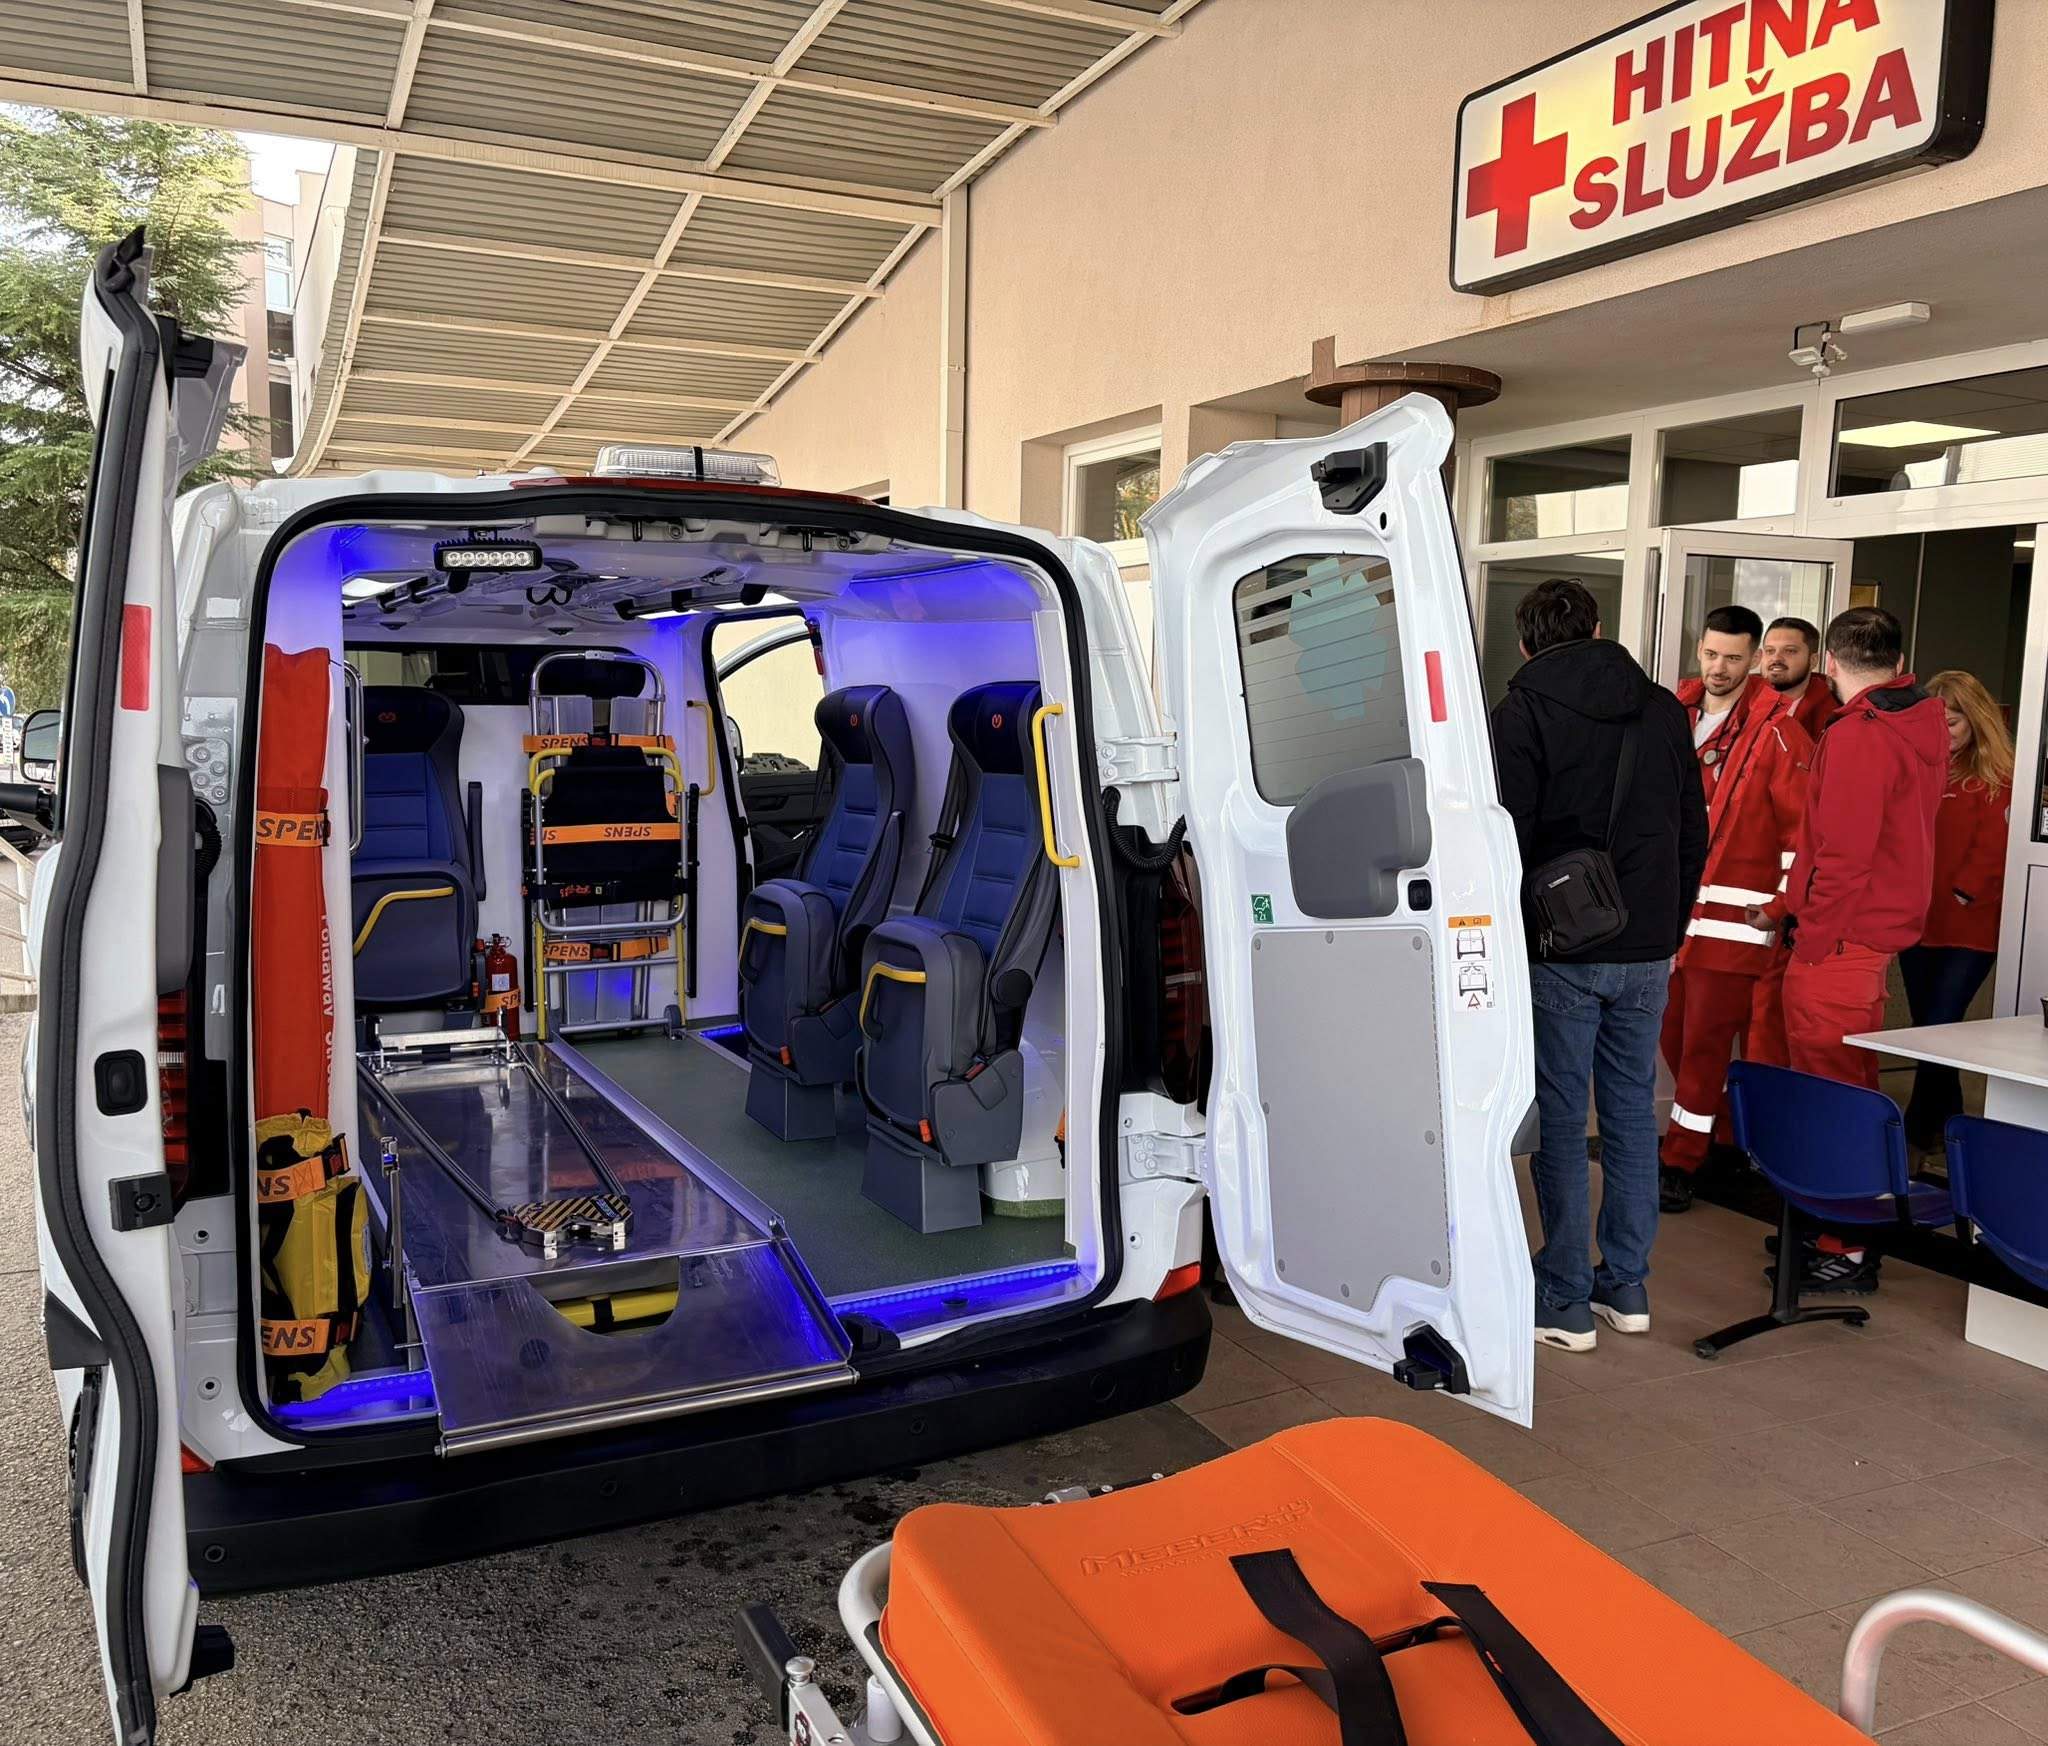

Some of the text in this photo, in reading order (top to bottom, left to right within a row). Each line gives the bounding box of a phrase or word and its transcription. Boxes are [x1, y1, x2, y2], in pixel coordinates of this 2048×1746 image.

[1613, 0, 1880, 125] HITNA
[1569, 49, 1922, 230] SLUŽBA
[604, 826, 651, 838] SPENS
[320, 914, 333, 1016] oldaway
